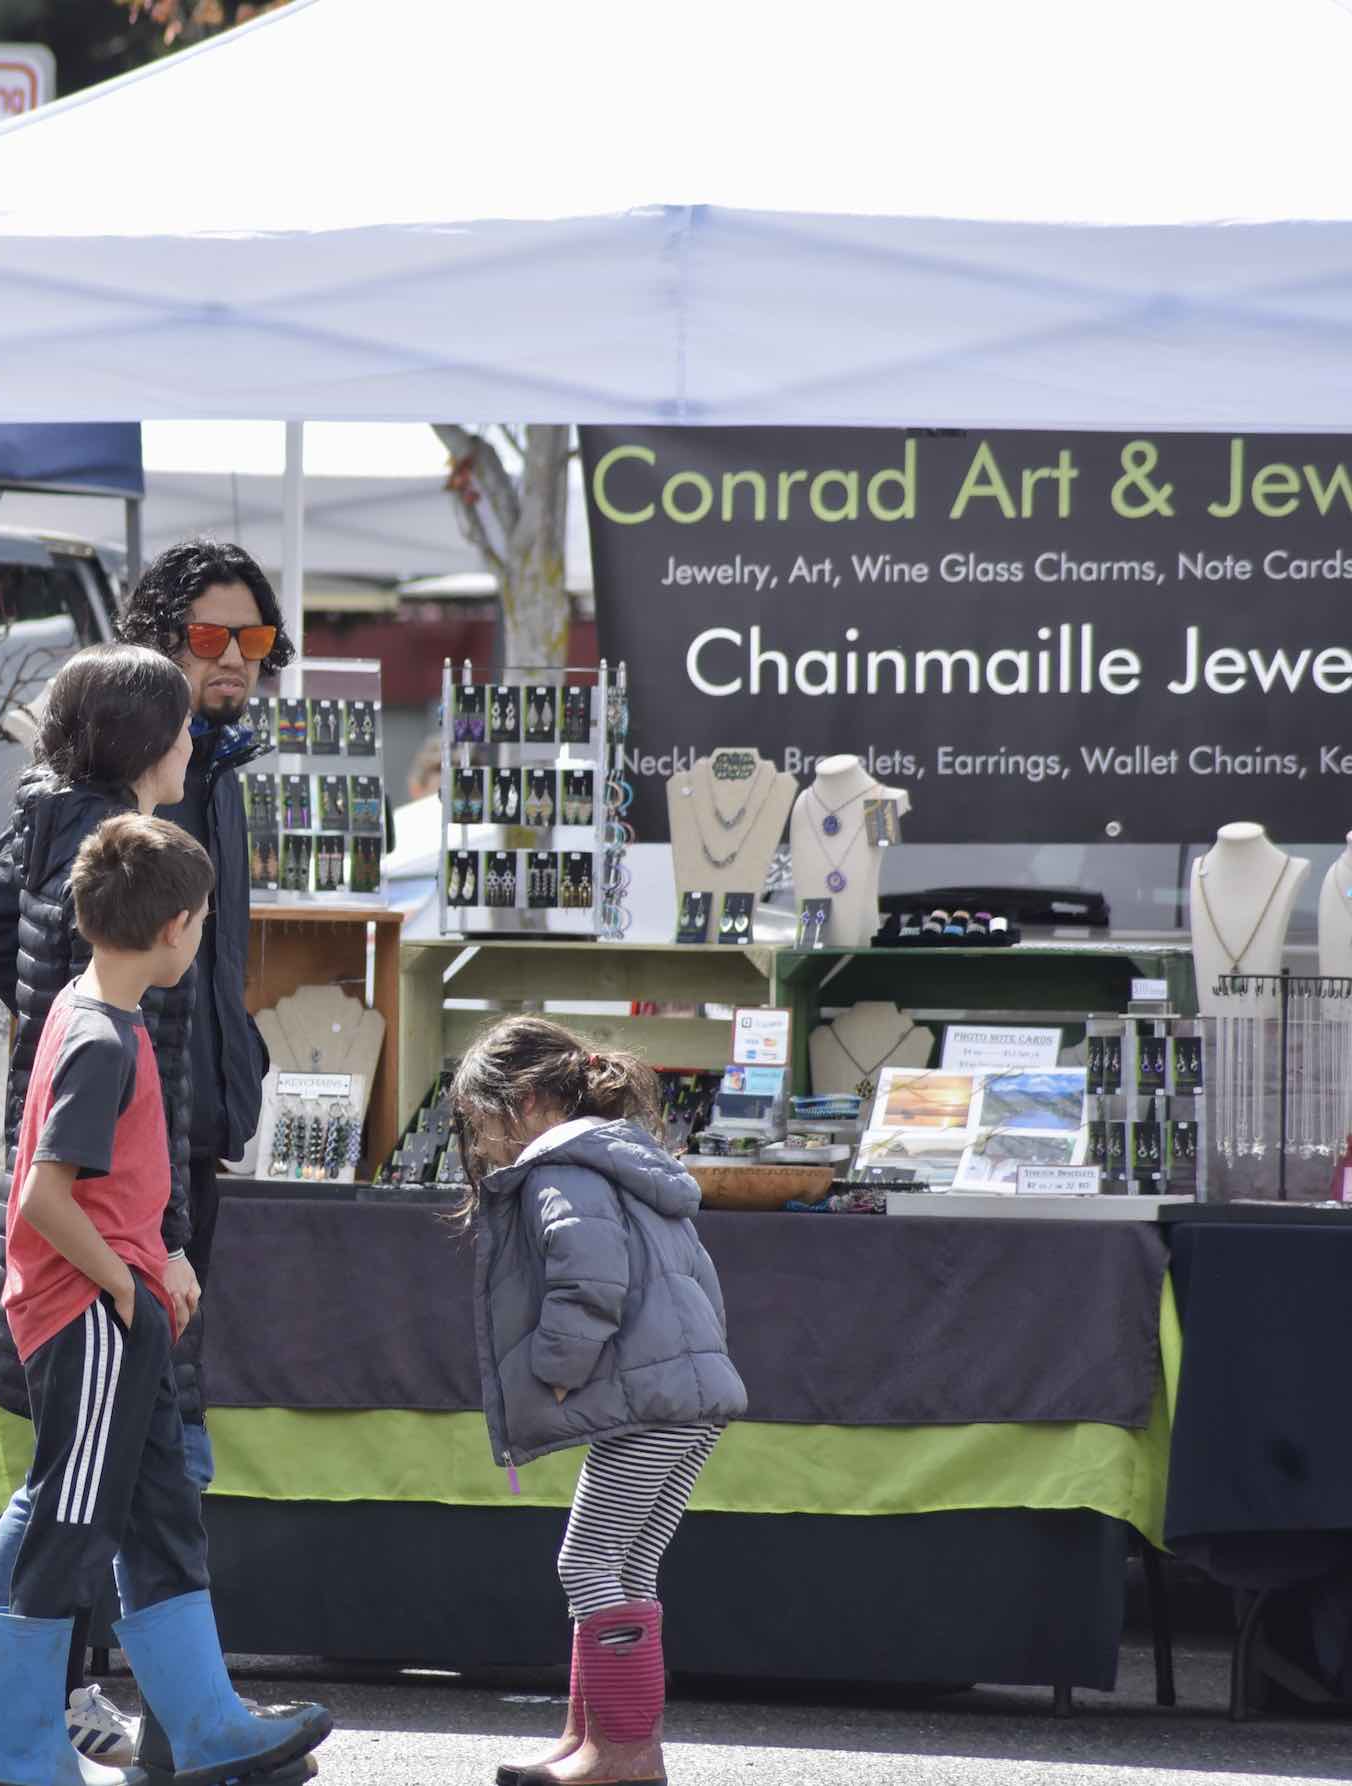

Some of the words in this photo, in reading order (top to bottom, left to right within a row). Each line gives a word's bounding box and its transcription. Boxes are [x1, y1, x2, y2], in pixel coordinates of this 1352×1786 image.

[593, 439, 917, 524] Conrad
[950, 440, 1080, 519] Art
[1111, 440, 1175, 518] &
[1207, 438, 1352, 518] Jew
[661, 555, 778, 591] Jewelry,
[788, 555, 842, 589] Art,
[851, 553, 929, 583] Wine
[940, 552, 1024, 583] Glass
[1035, 551, 1166, 585] Charms,
[1177, 551, 1253, 580] Note
[1263, 549, 1352, 580] Cards
[686, 623, 1142, 696] Chainmaille
[1167, 625, 1352, 695] Jewe
[784, 744, 925, 780] Brlets,
[937, 746, 1070, 782] Earrings,
[1080, 745, 1178, 776] Wallet
[1188, 745, 1308, 780] Chains,
[954, 1031, 987, 1043] PHOTO
[990, 1033, 1017, 1045] NOTE
[1018, 1034, 1054, 1046] CARDS
